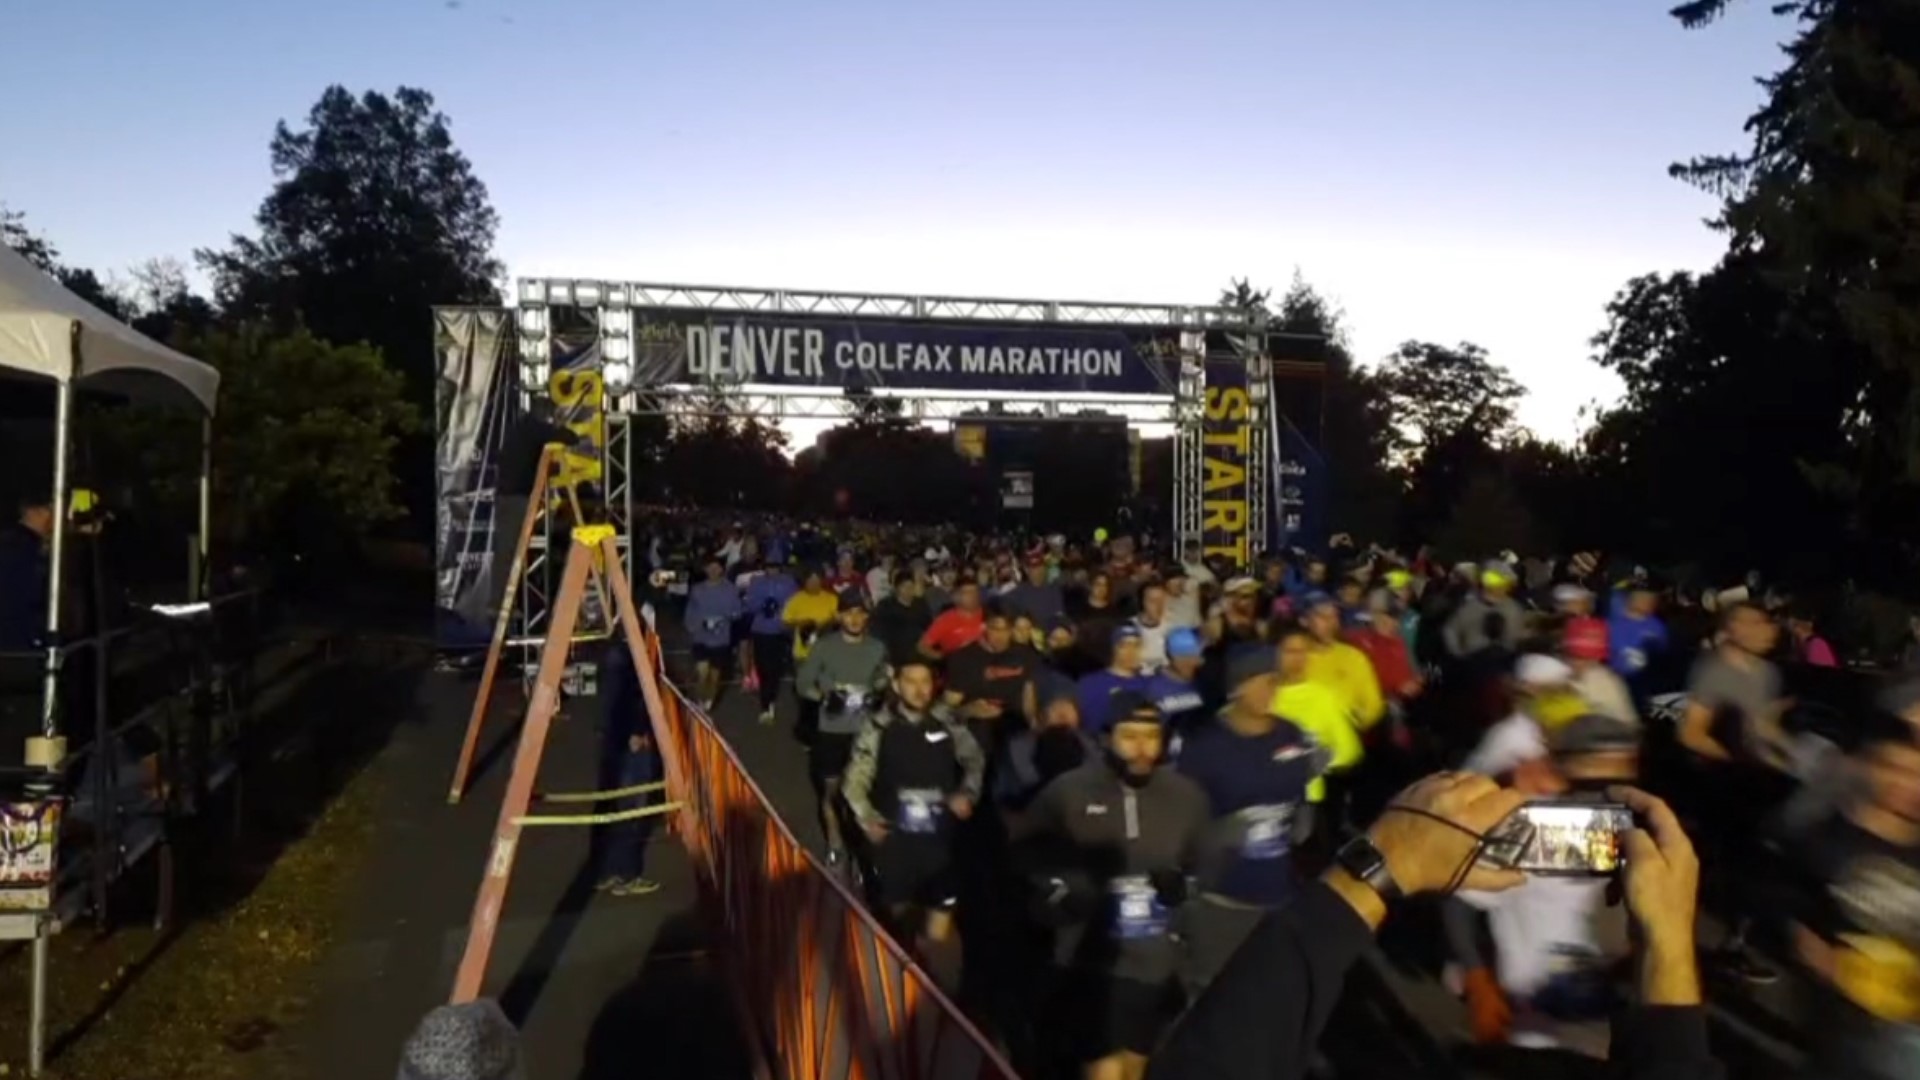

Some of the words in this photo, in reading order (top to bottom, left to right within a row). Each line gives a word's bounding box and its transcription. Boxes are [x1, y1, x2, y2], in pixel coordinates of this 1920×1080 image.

[686, 324, 824, 377] DENVER
[835, 341, 952, 372] COLFAX
[960, 346, 1122, 376] MARATHON
[1203, 386, 1250, 568] START
